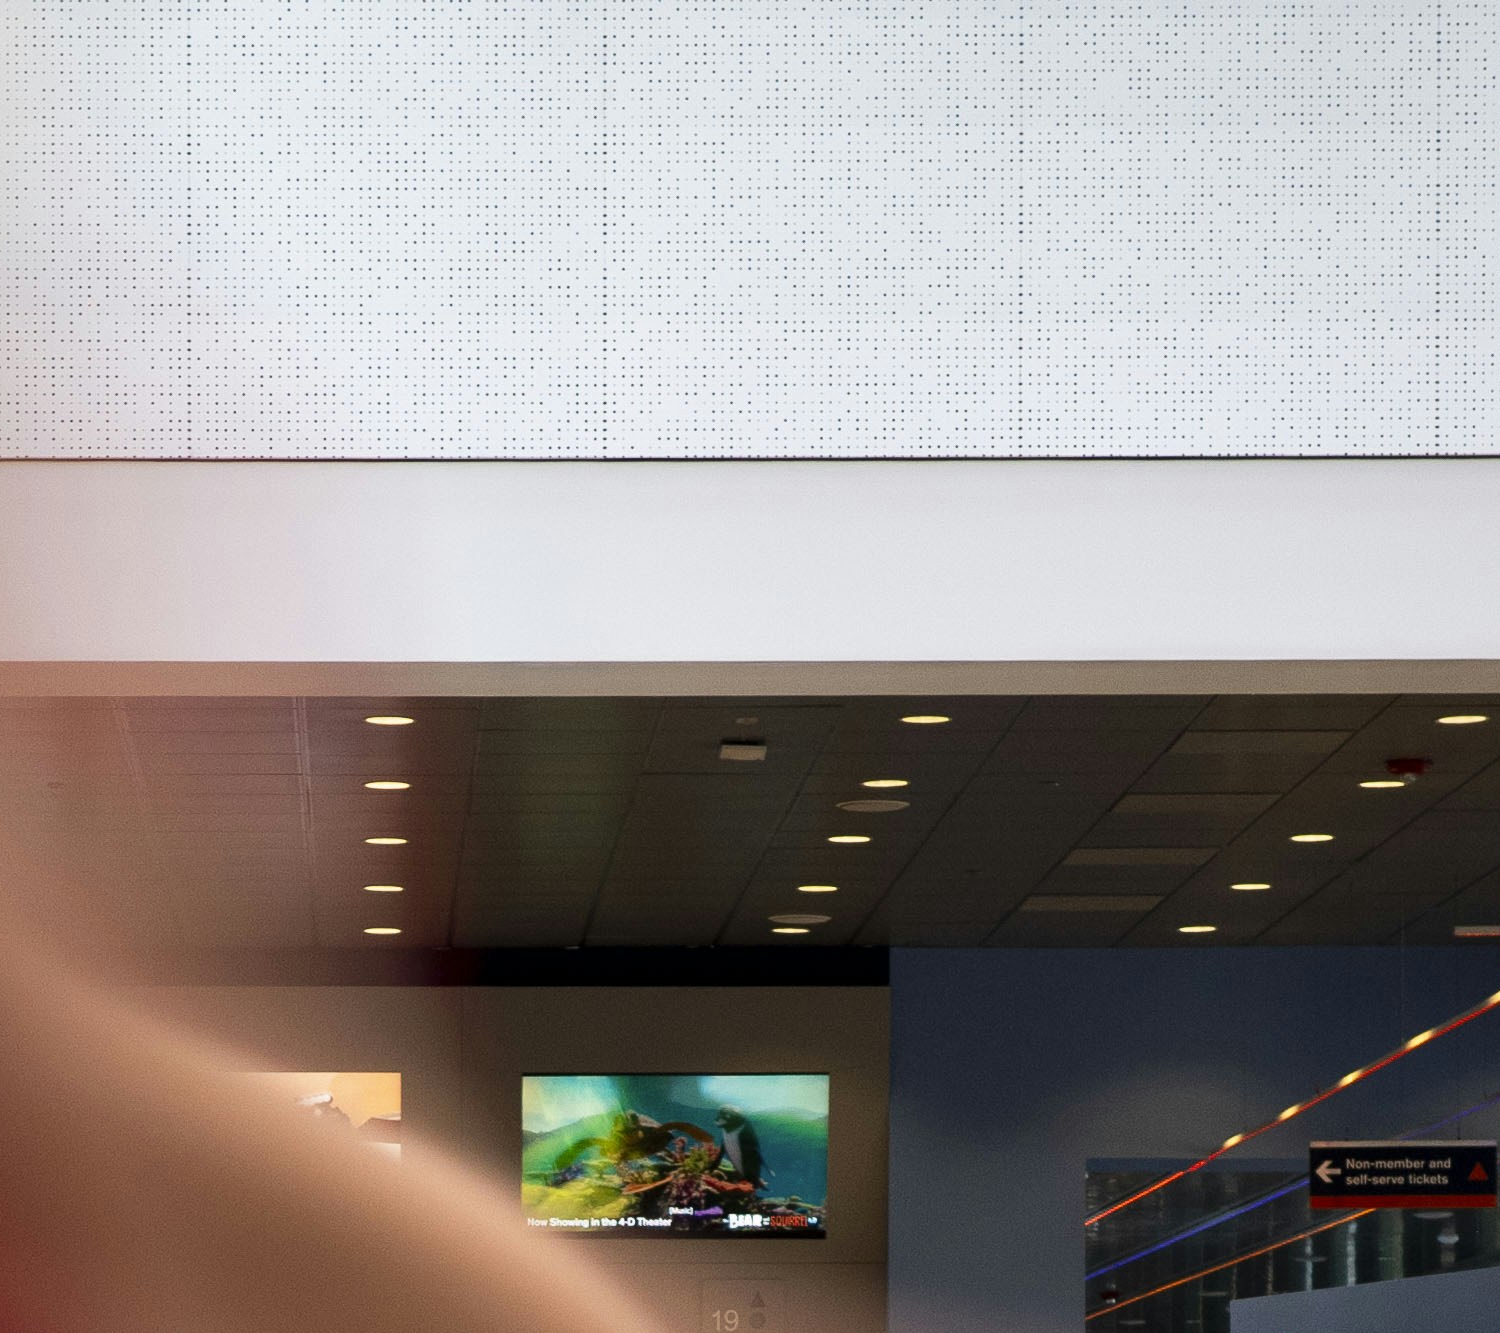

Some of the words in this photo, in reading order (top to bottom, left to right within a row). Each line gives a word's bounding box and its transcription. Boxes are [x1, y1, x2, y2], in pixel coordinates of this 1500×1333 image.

[1345, 1158, 1425, 1169] Non-member
[1429, 1157, 1452, 1169] and
[1345, 1174, 1405, 1185] self-serve
[1408, 1174, 1449, 1185] tickets
[527, 1218, 548, 1227] Now
[549, 1217, 590, 1228] Showing
[591, 1217, 600, 1227] in
[601, 1217, 617, 1227] the
[637, 1217, 673, 1227] Theater
[711, 1309, 739, 1332] 19
